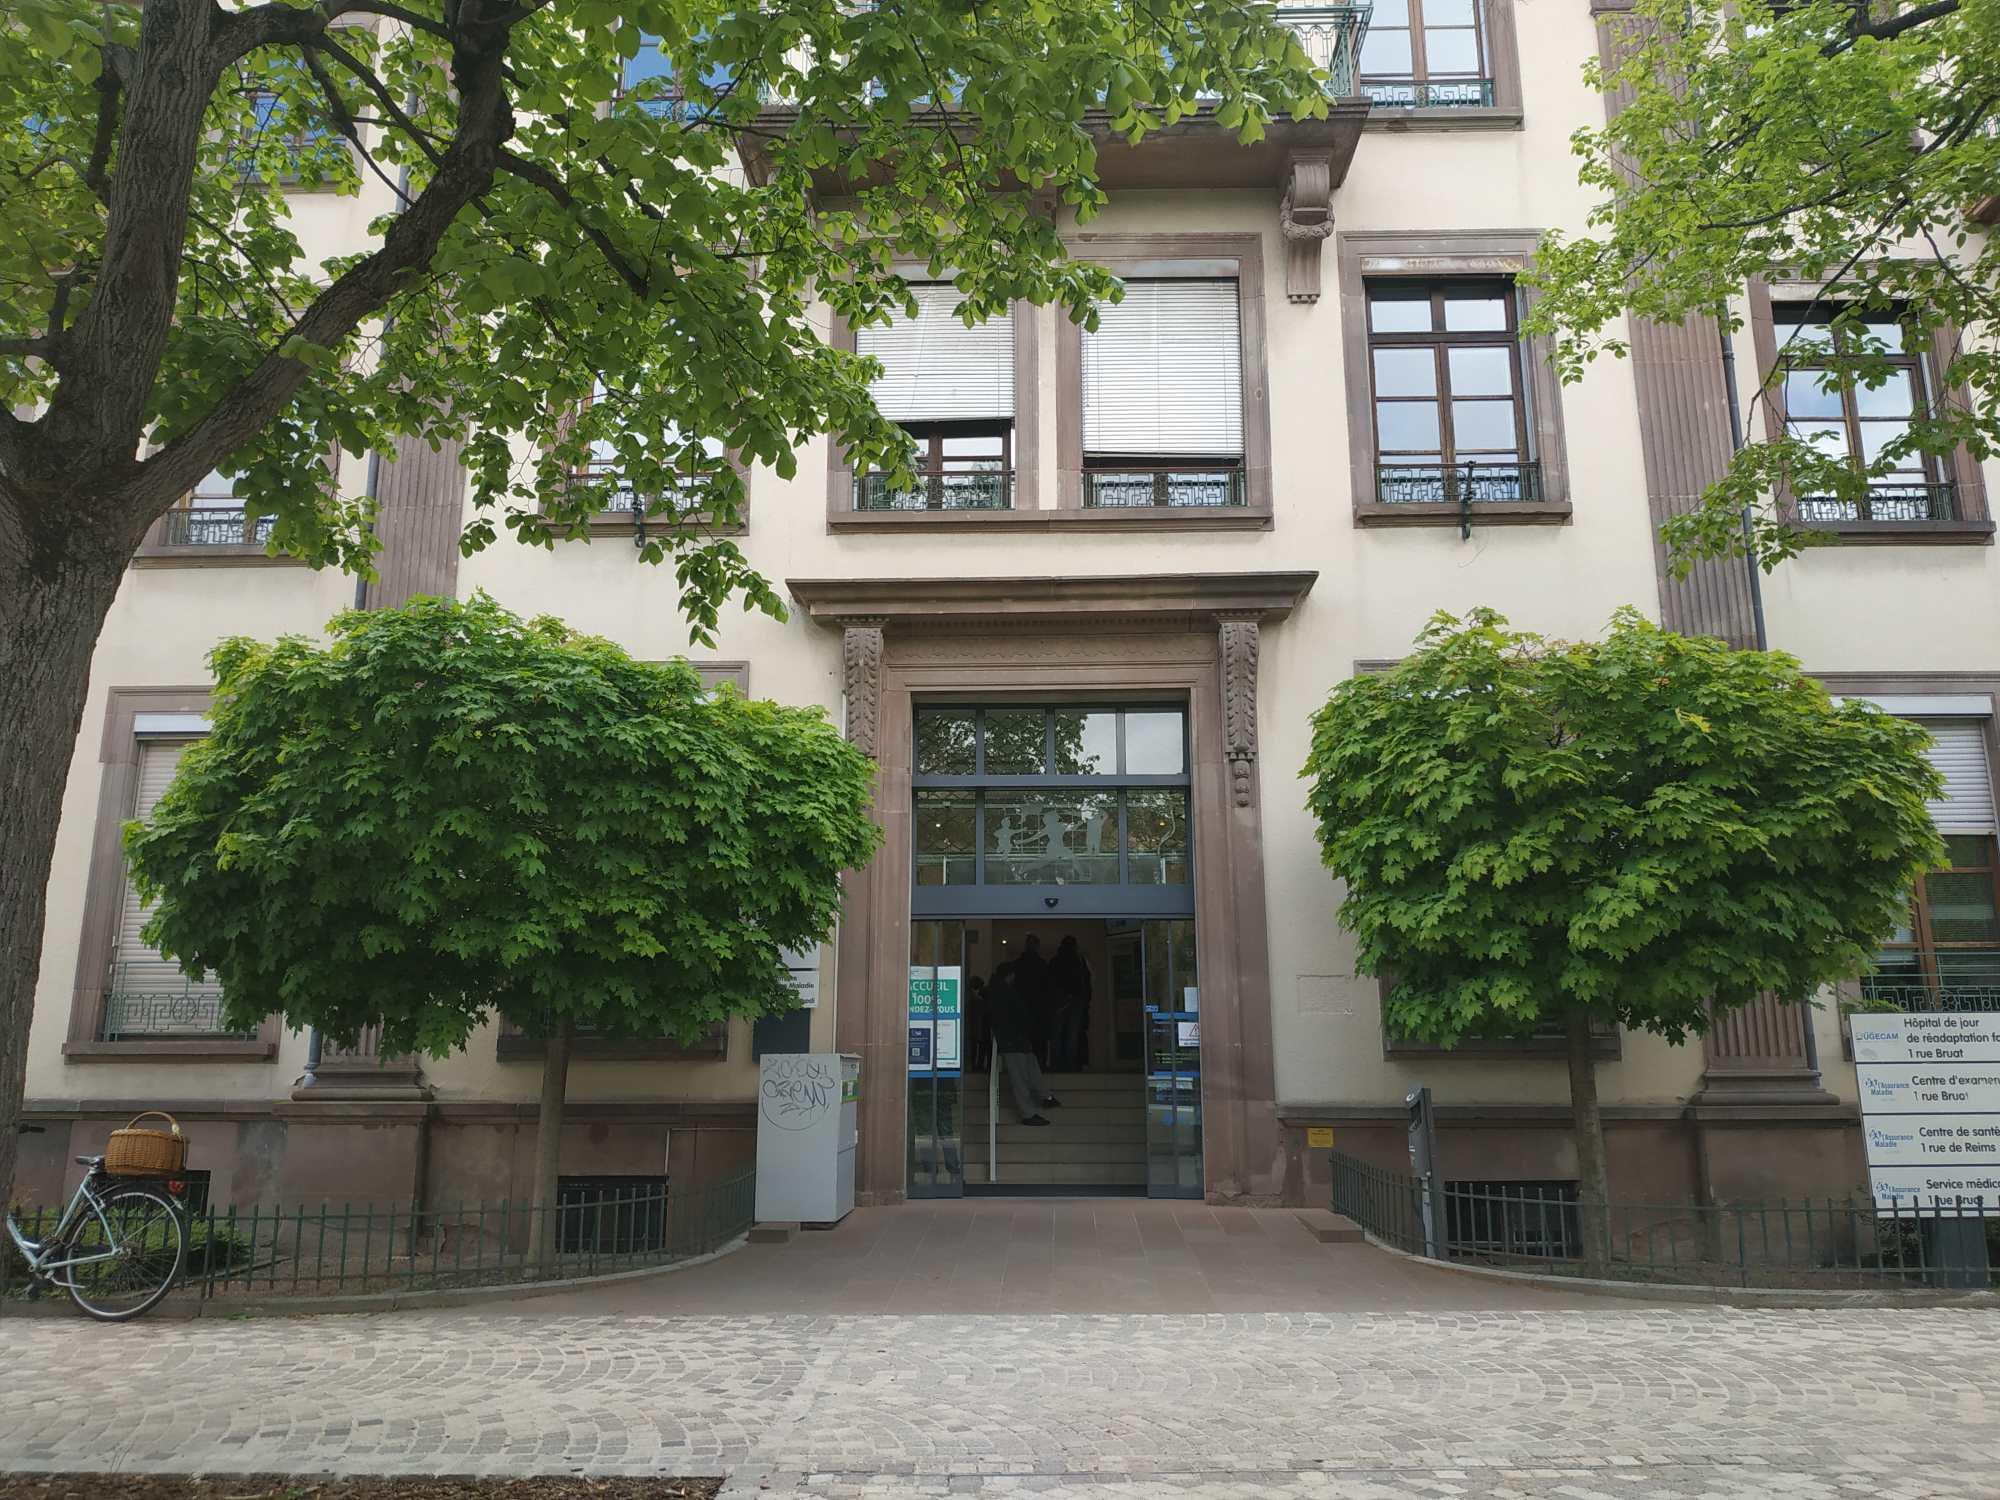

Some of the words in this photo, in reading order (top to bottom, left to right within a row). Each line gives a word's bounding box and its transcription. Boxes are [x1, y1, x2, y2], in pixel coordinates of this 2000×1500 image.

[910, 981, 950, 992] CCUIL
[1904, 1017, 1940, 1030] Hôpital
[1943, 1016, 1957, 1028] de
[1960, 1017, 1980, 1030] jour
[1906, 1032, 1920, 1043] de
[1922, 1032, 1990, 1045] réadaptation
[1908, 1048, 1913, 1058] 1
[1916, 1050, 1933, 1058] rue
[1936, 1048, 1964, 1058] Bruat
[1912, 1076, 1946, 1086] Centre
[1913, 1090, 1918, 1101] 1
[1922, 1092, 1939, 1101] rue
[1919, 1126, 1954, 1137] Centre
[1956, 1126, 1970, 1137] de
[1972, 1126, 2000, 1137] santé
[1920, 1142, 1926, 1152] 1
[1928, 1144, 1946, 1152] rue
[1948, 1142, 1962, 1152] de
[1964, 1142, 1996, 1153] Reims
[1926, 1179, 1963, 1189] Service
[1928, 1195, 1933, 1205] 1
[1936, 1196, 1953, 1205] ue
